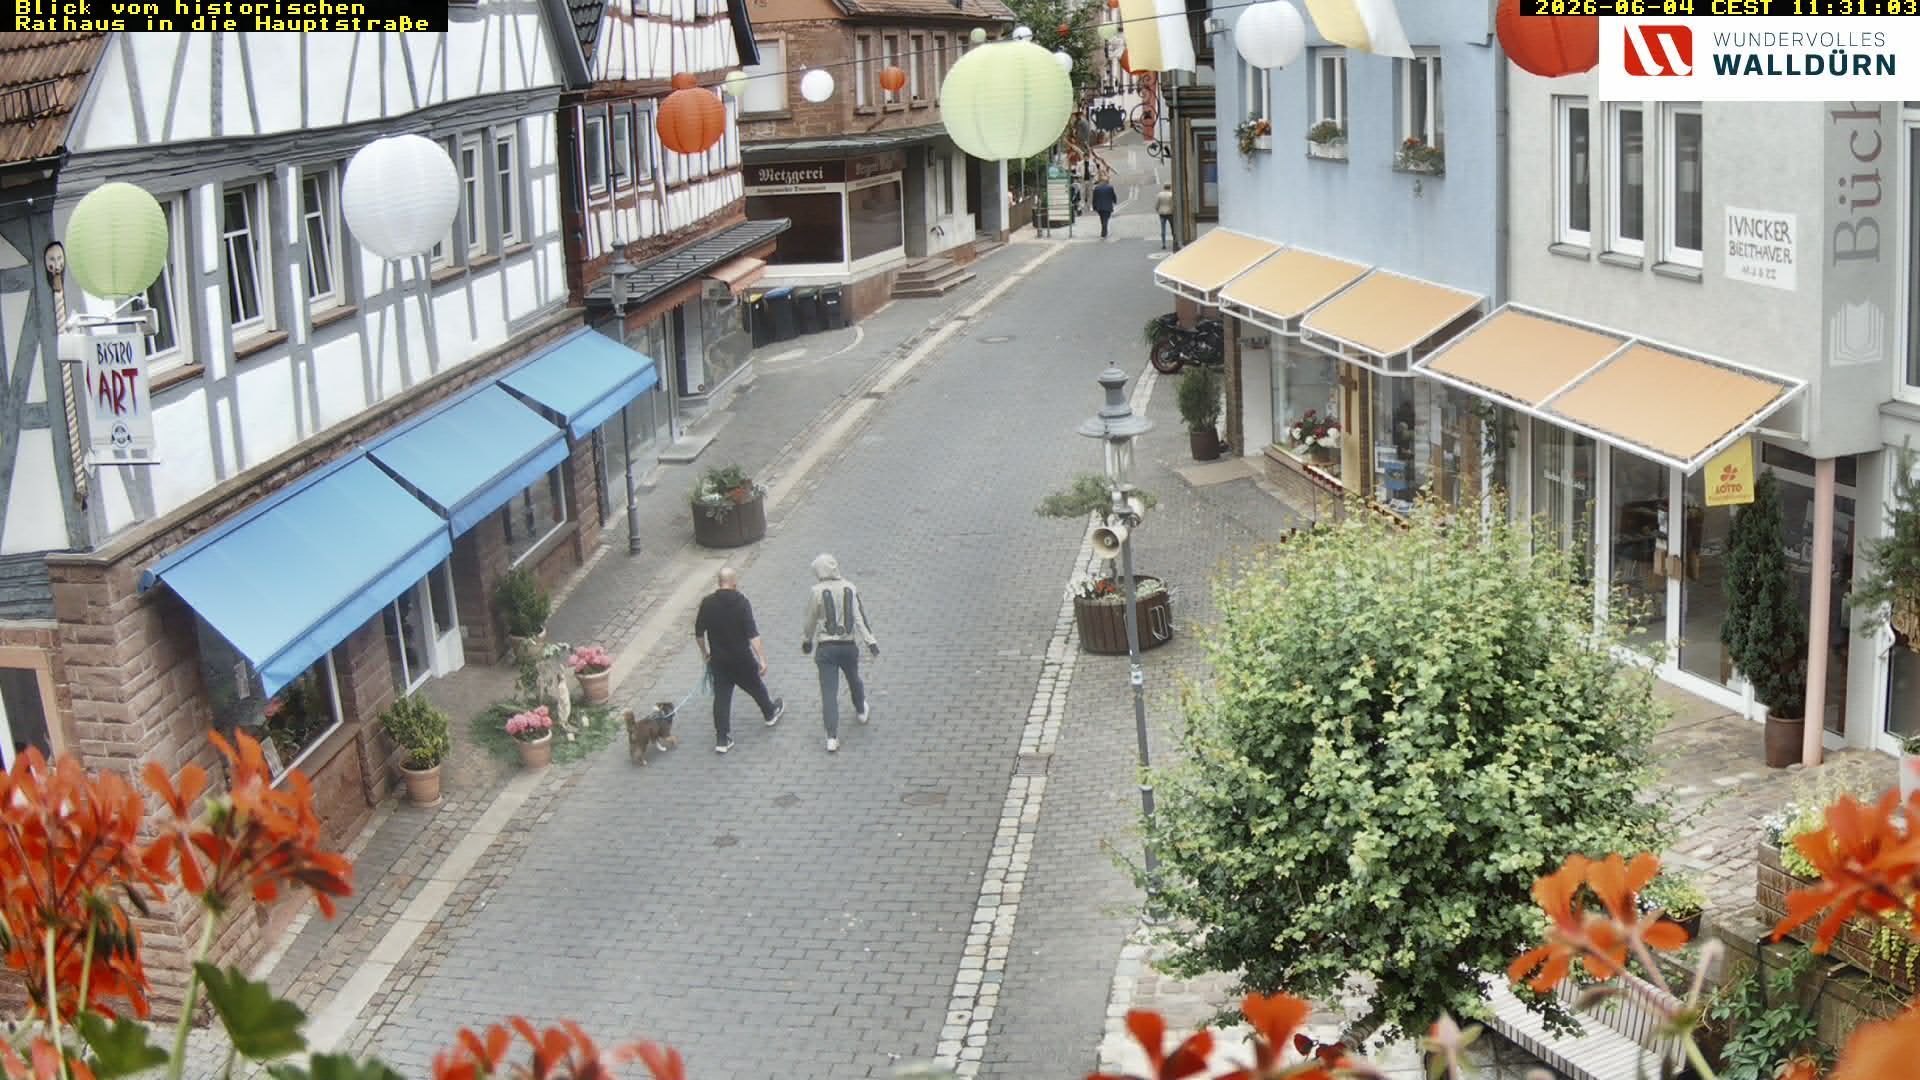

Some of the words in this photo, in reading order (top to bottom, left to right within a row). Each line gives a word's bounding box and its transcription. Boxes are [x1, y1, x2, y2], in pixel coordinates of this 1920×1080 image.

[758, 166, 824, 184] Metzgerei
[1728, 215, 1793, 245] IVNCKER
[98, 367, 139, 417] ART
[1715, 483, 1744, 494] LOTTO
